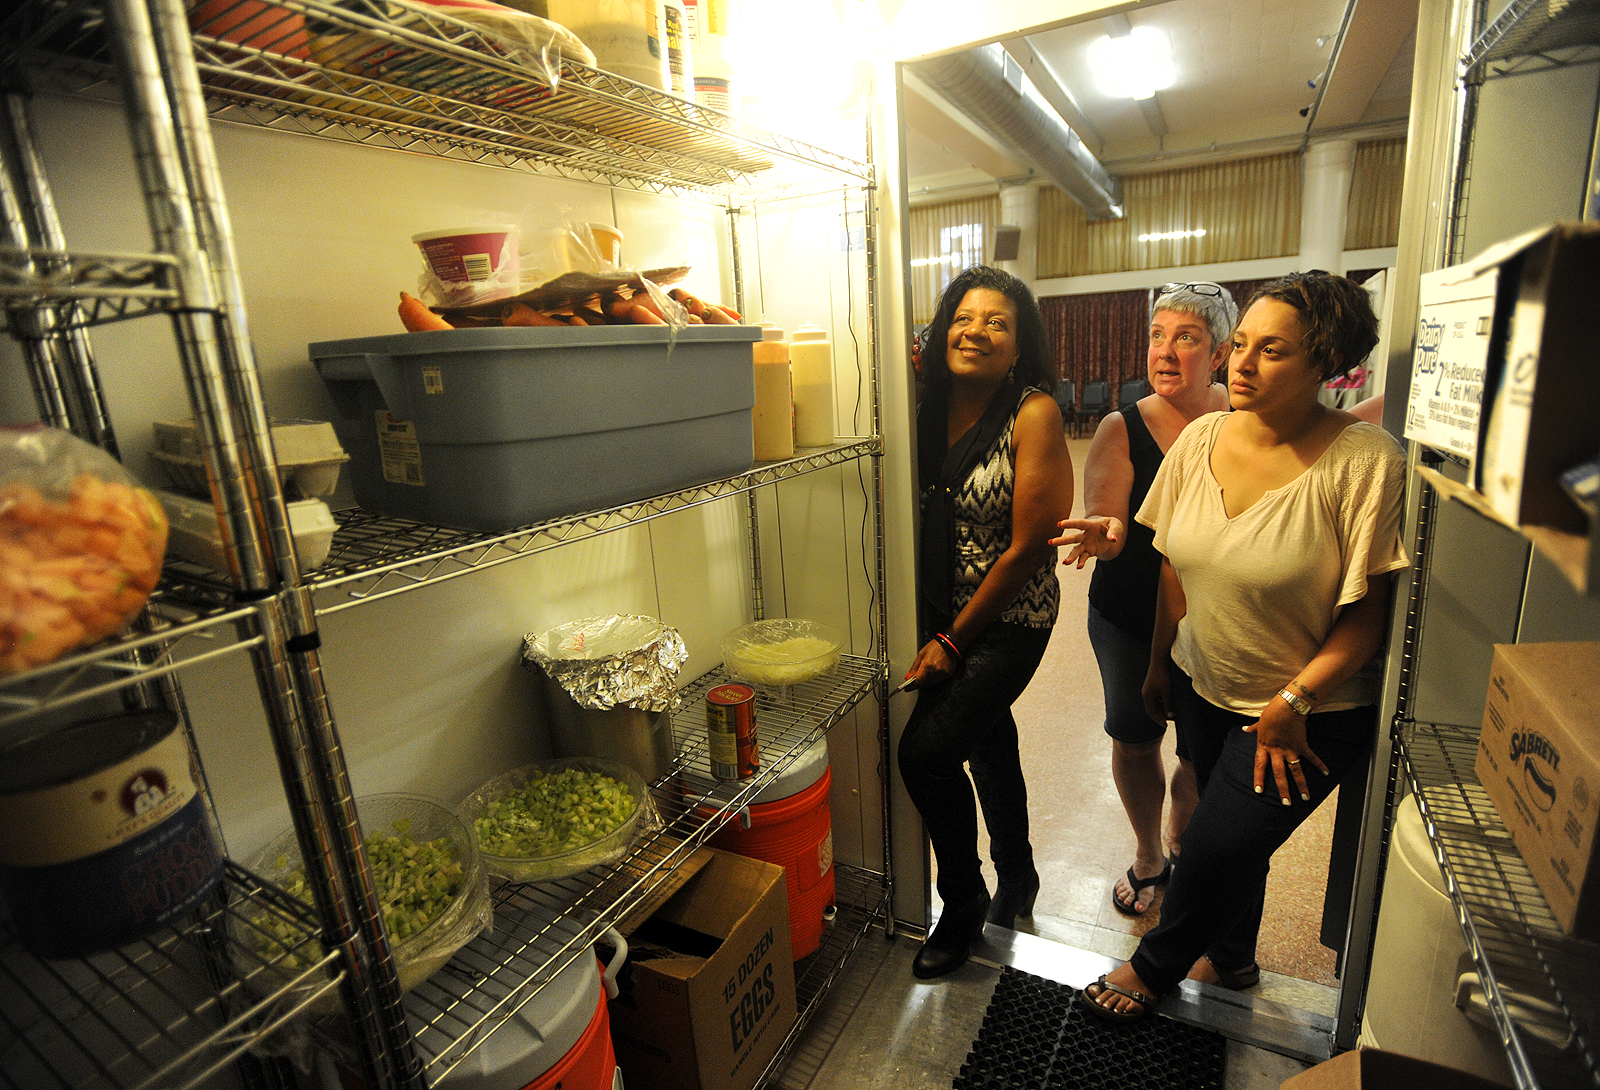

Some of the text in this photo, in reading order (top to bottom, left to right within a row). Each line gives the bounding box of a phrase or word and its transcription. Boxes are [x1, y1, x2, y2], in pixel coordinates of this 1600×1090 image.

[1418, 317, 1445, 349] Dairy
[1414, 346, 1438, 377] Pure
[1449, 382, 1483, 404] Fat Milk
[1408, 405, 1416, 426] 12
[1510, 732, 1560, 770] SABRETT
[722, 926, 774, 1005] 15 DOZEN
[657, 978, 680, 996] EGGS
[730, 962, 775, 1054] EGGS
